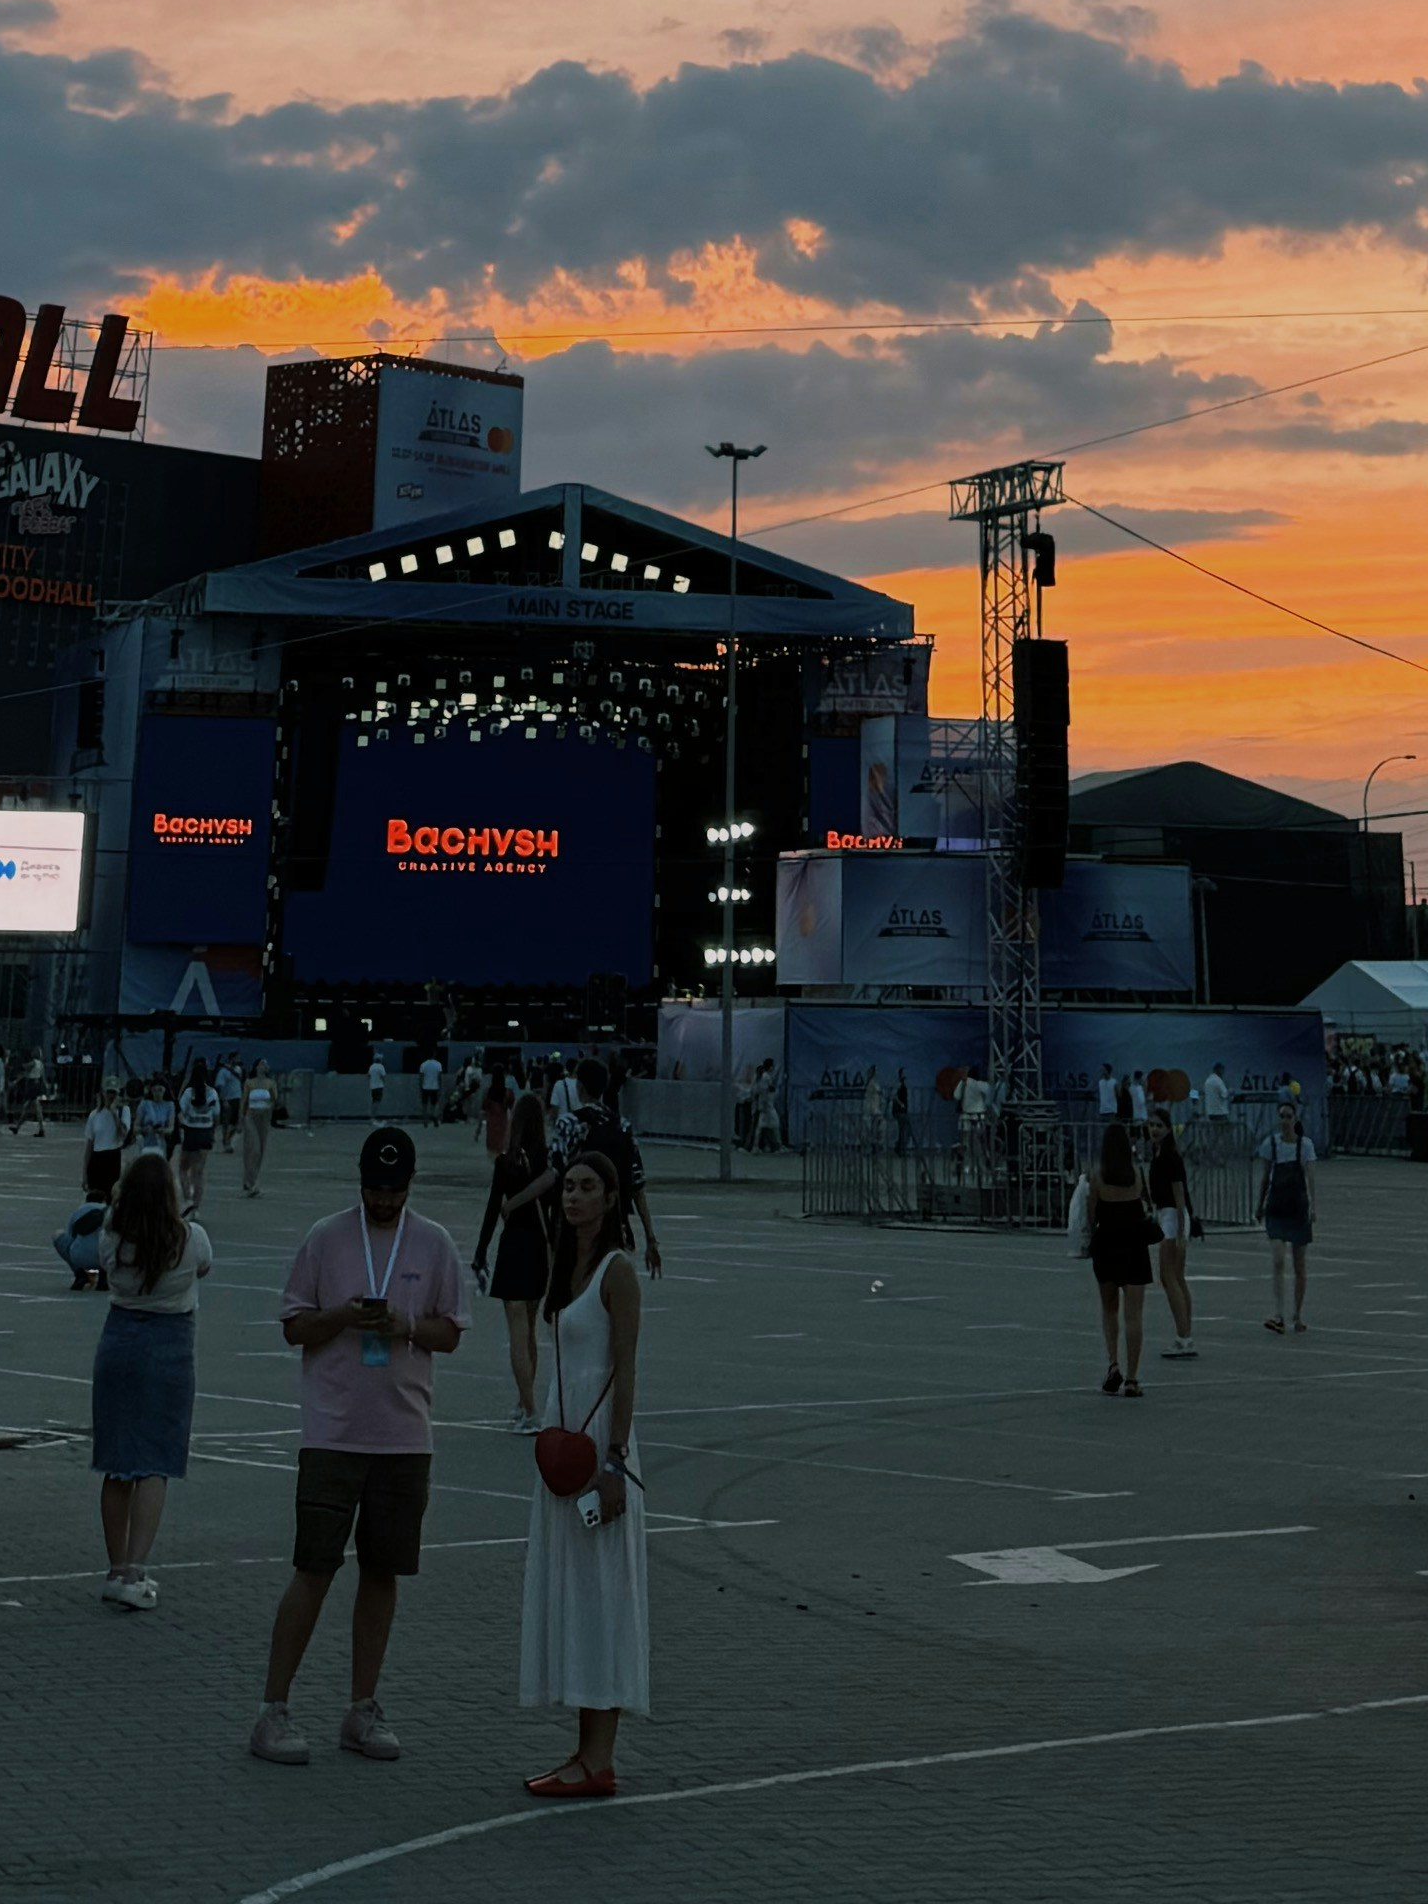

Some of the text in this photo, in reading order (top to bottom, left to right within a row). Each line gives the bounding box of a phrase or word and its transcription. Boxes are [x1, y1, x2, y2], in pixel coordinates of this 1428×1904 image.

[507, 597, 635, 621] MAIN STAGE
[483, 862, 547, 874] AGENCY
[821, 1067, 866, 1088] ATLA
[1241, 1069, 1279, 1091] ATLA
